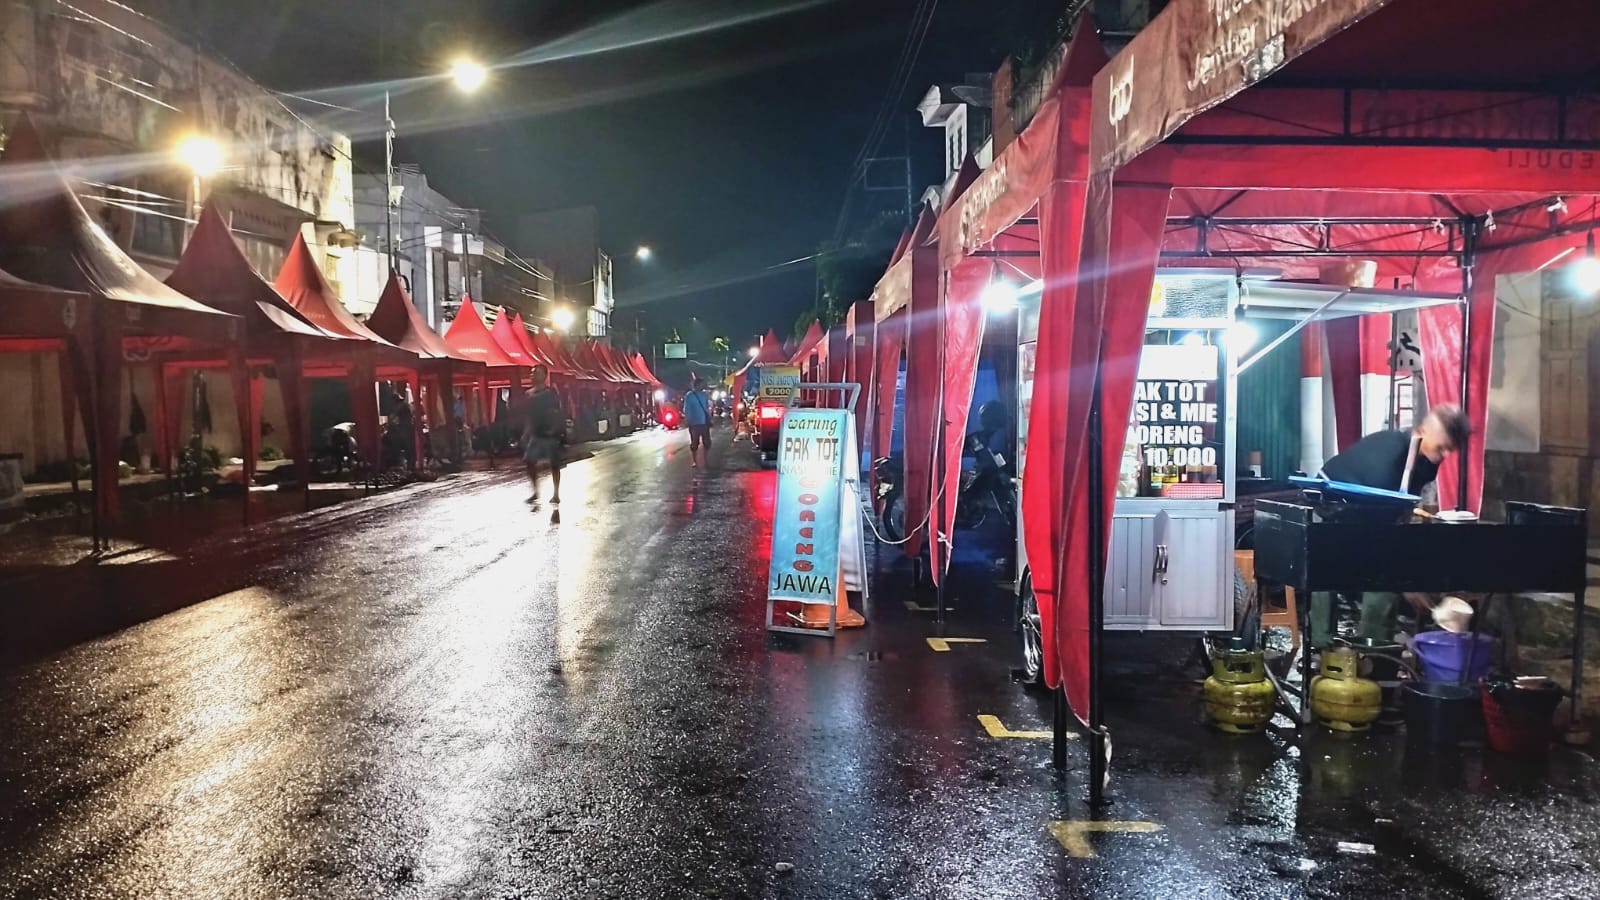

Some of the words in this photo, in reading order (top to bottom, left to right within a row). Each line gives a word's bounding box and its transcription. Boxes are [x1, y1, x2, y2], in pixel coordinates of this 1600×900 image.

[1133, 382, 1161, 401] AK
[1165, 382, 1207, 402] TOT
[1130, 402, 1158, 422] SI
[1160, 403, 1176, 420] &
[1180, 402, 1217, 423] MIE
[787, 418, 838, 437] warung
[1134, 425, 1203, 445] ORENG
[784, 437, 810, 462] PAK
[1143, 446, 1216, 467] 10.000
[773, 572, 832, 595] JAWA
